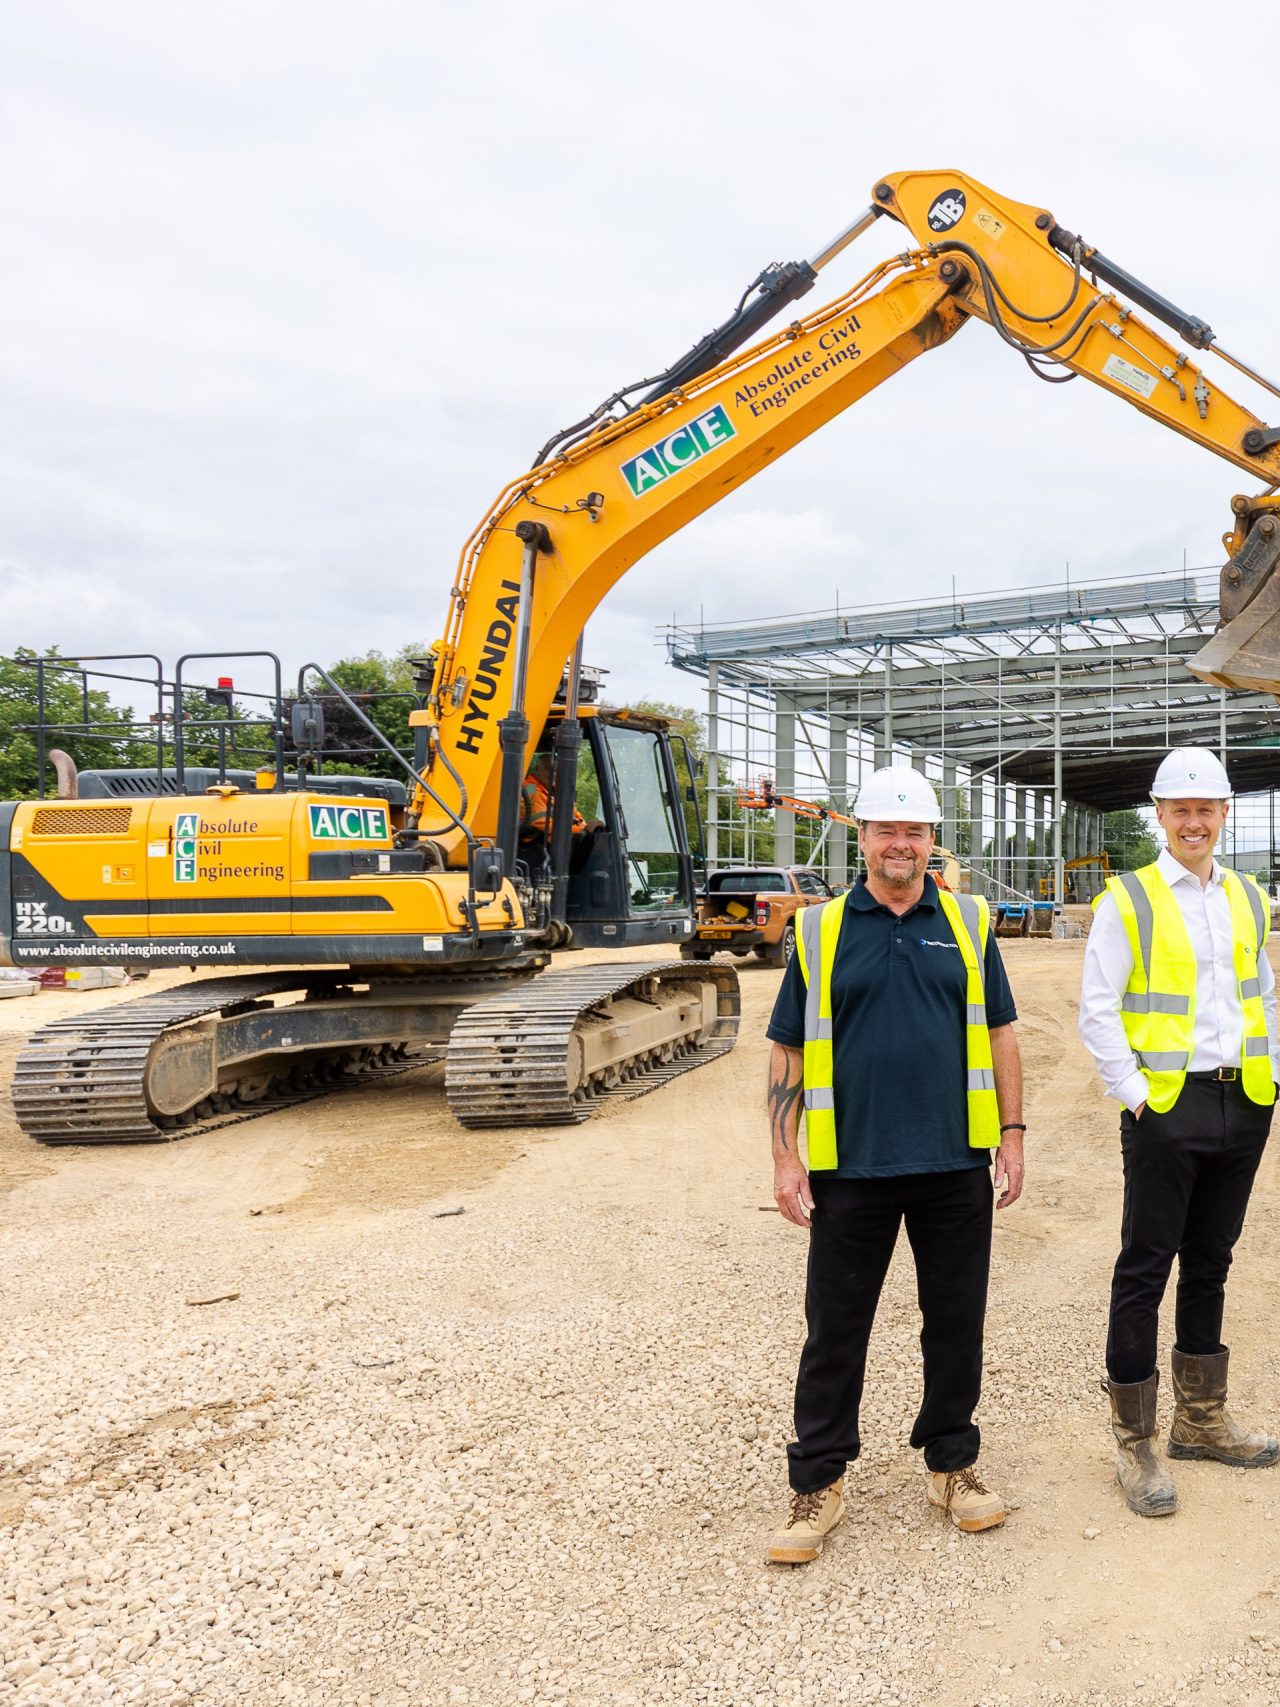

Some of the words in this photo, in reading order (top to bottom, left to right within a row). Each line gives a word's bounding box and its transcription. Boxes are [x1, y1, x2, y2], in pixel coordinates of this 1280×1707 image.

[734, 351, 813, 408] Absolute
[818, 315, 861, 350] Civil
[749, 341, 861, 417] Engineering
[635, 411, 727, 494] ACE
[456, 579, 521, 755] HYUNDAI
[177, 816, 258, 836] Absolute
[314, 808, 383, 838] ACE
[177, 840, 221, 858] Civil
[179, 860, 284, 881] Engineering
[16, 903, 48, 915] HX
[16, 915, 76, 933] 220L
[18, 942, 235, 958] www.absolutecivilengineering.co.uk
